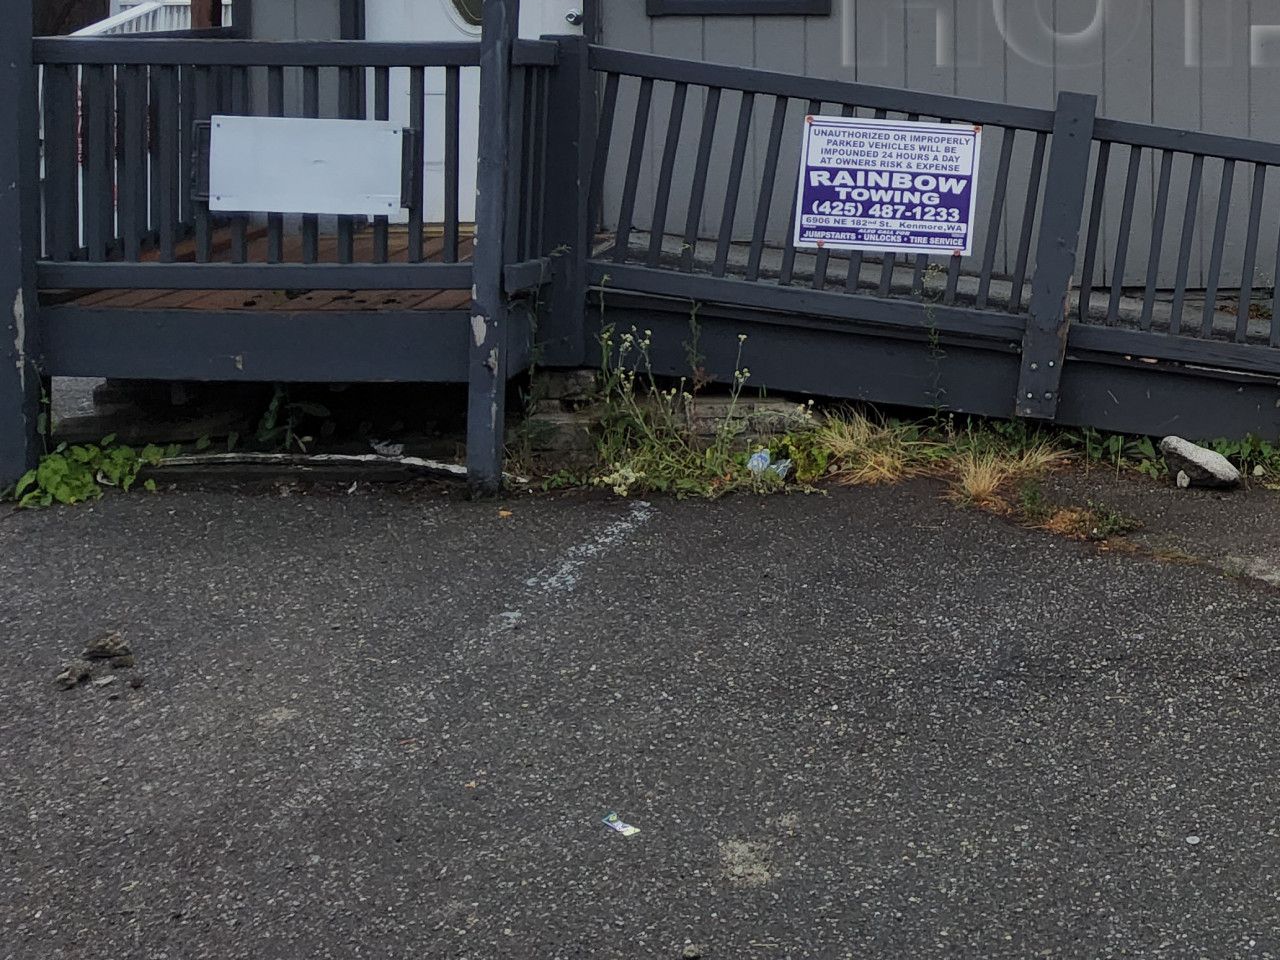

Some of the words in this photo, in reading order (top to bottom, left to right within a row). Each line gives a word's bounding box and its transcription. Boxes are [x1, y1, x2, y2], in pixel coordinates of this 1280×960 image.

[813, 129, 891, 141] UNAUTHORIZED
[893, 133, 907, 142] OR
[910, 134, 971, 146] IMPROPERLY
[826, 138, 866, 148] PARKED
[868, 141, 916, 151] VEHICLES
[918, 144, 941, 153] WILL
[944, 146, 957, 154] BE
[820, 147, 879, 158] IMPOUNDED
[882, 151, 894, 159] 24
[896, 152, 930, 161] HOURS
[932, 154, 939, 162] A
[942, 155, 961, 163] DAY
[835, 157, 877, 167] OWNERS
[879, 160, 903, 169] RISK
[906, 161, 913, 169] &
[916, 162, 960, 172] EXPENSE
[809, 170, 968, 195] RAINBOW
[835, 186, 941, 205] TOWING
[812, 200, 863, 217] (425)
[868, 204, 960, 222] 487-1233
[805, 216, 831, 224] 6906
[850, 219, 877, 227] 182nd
[879, 220, 892, 228] St.
[803, 230, 857, 240] JUMPSTARTS
[863, 233, 902, 243] UNLOCKS
[909, 235, 929, 244] TIRE
[929, 236, 964, 246] SERVICE
